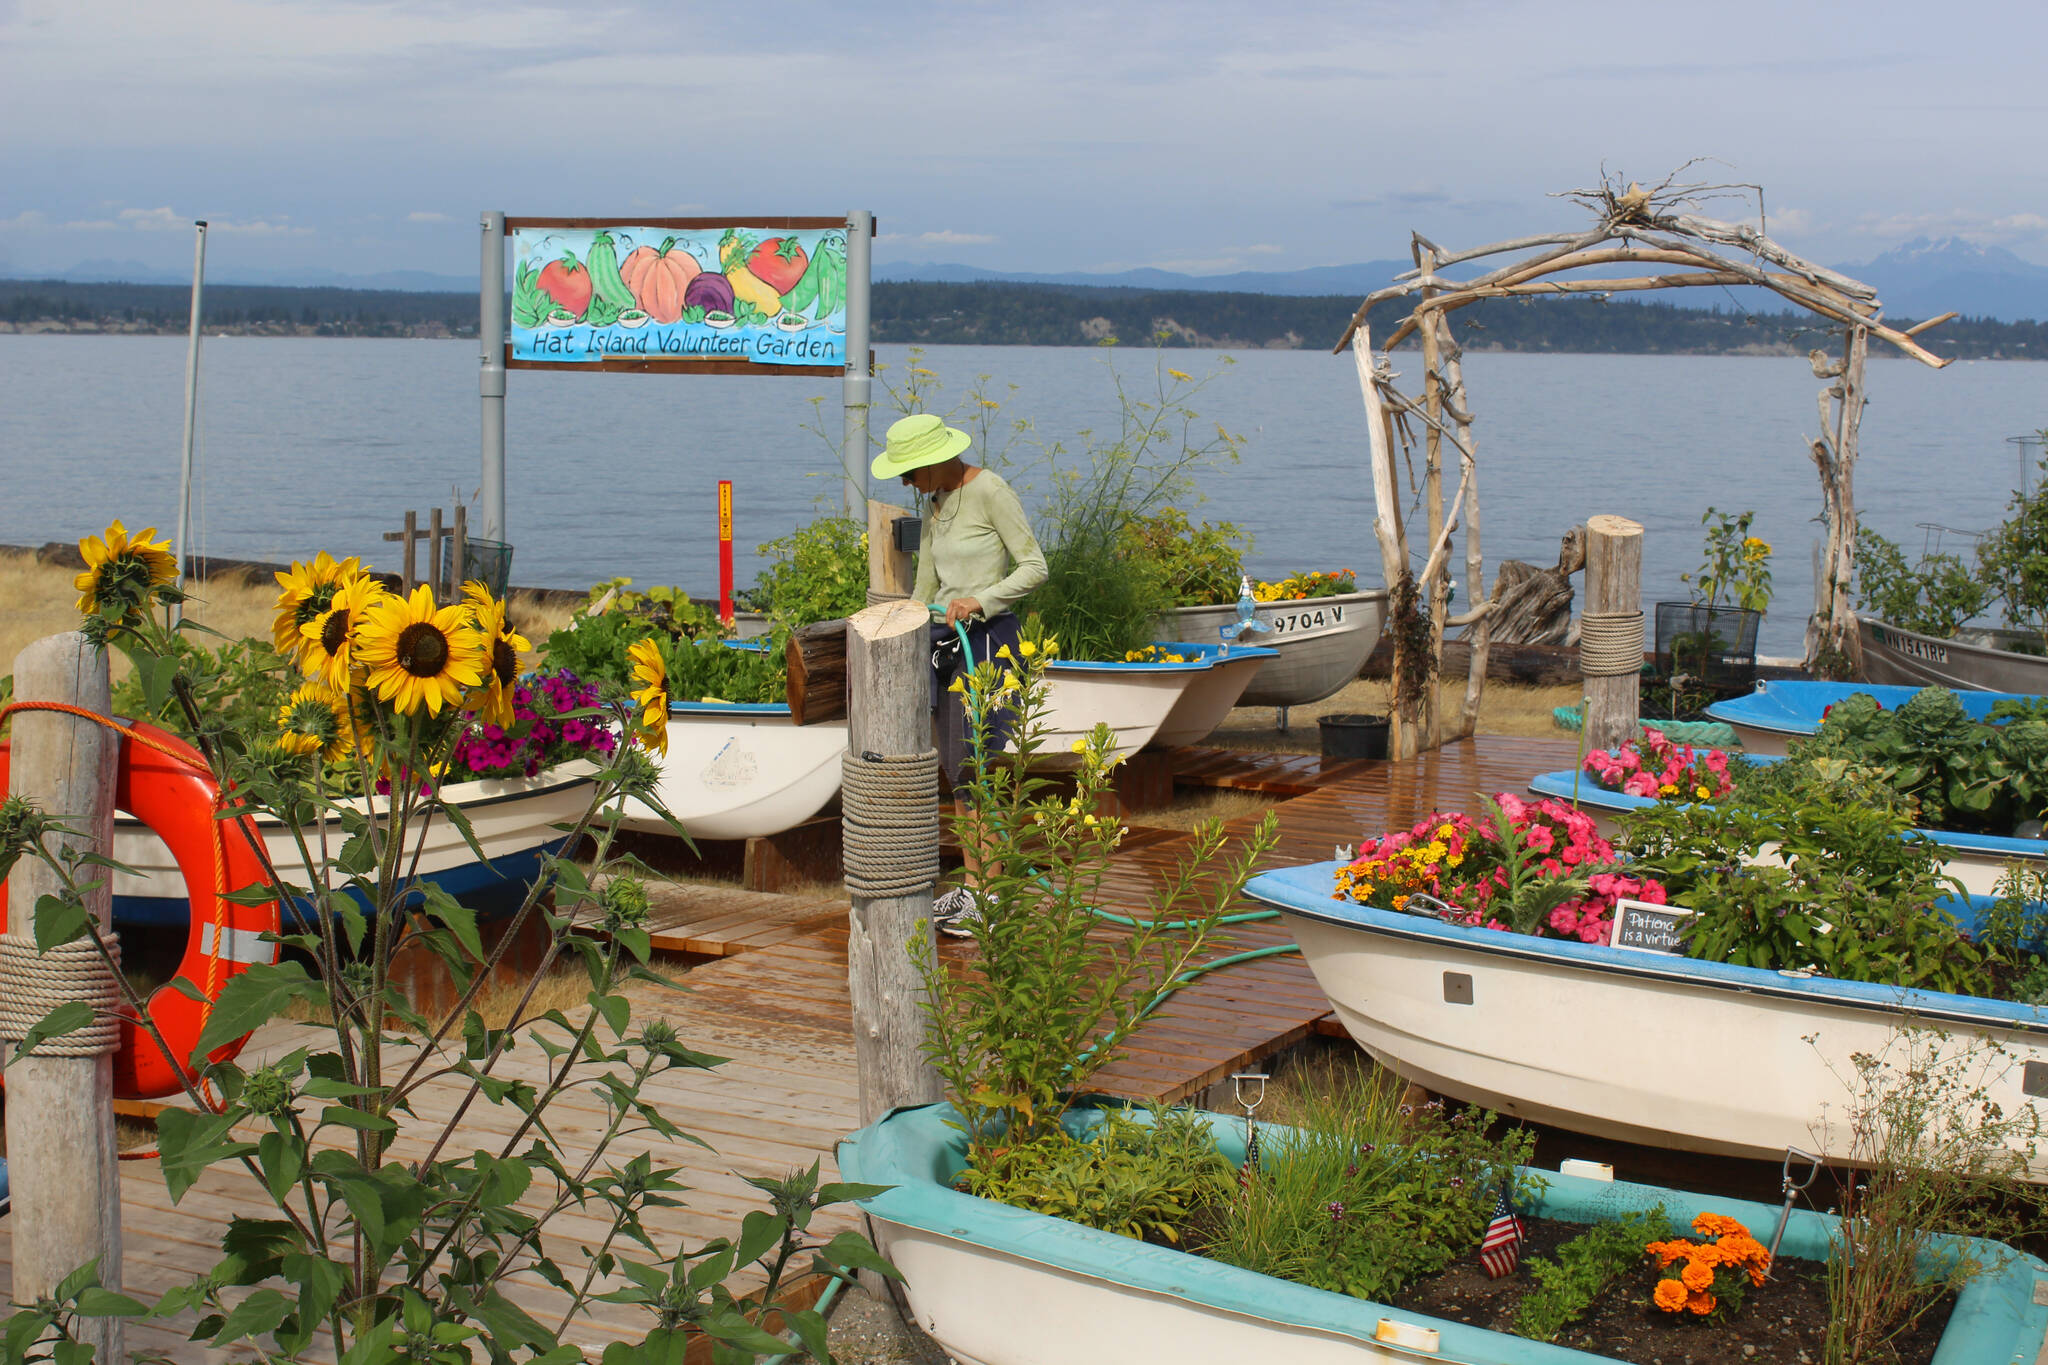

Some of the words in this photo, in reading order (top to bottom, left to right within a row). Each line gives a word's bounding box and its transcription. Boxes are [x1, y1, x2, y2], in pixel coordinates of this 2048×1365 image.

[533, 330, 574, 353] Hat
[585, 329, 649, 353] Island
[657, 329, 750, 354] Volunteer
[756, 332, 835, 358] Garden
[1275, 610, 1325, 633] 9704
[1332, 606, 1342, 622] V
[1628, 912, 1676, 932] Patienc
[1624, 928, 1633, 941] is
[1635, 931, 1643, 942] a
[1645, 931, 1682, 947] virtue
